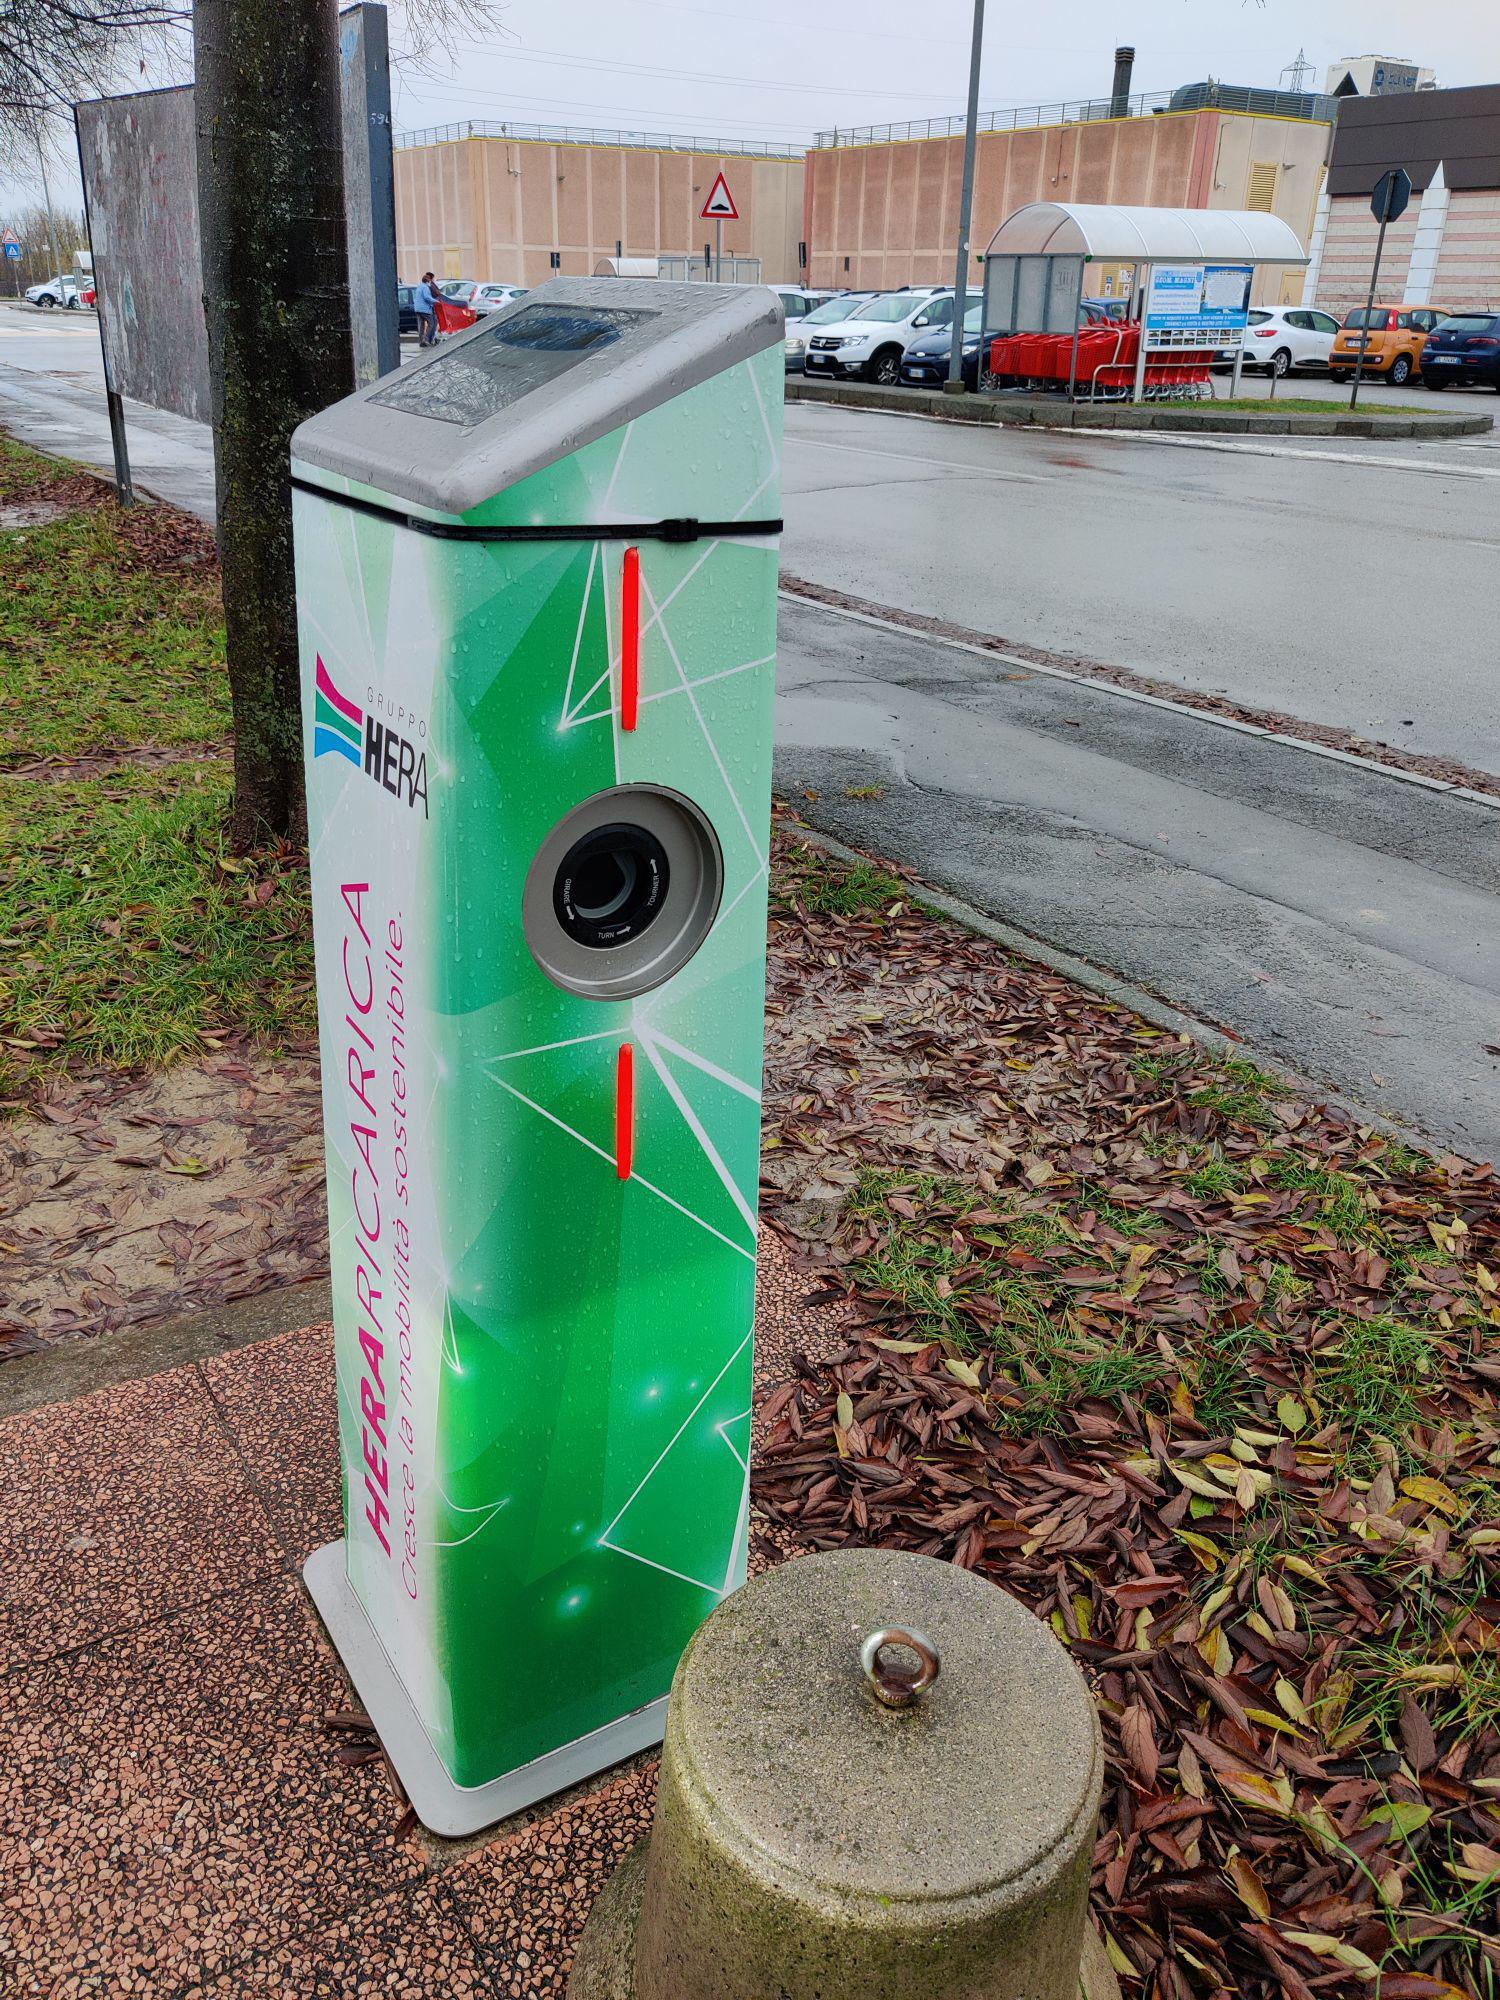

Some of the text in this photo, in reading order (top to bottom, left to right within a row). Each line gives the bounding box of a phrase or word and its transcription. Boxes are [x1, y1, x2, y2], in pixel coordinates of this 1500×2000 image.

[366, 685, 427, 738] GRUPPO
[364, 714, 429, 820] HERA
[563, 878, 572, 905] GIRARE
[647, 875, 660, 907] TOURNER
[598, 931, 615, 940] TURN
[340, 882, 392, 1558] HERARICARICA
[385, 911, 418, 1600] Cresce la mobilità sostenibile.
